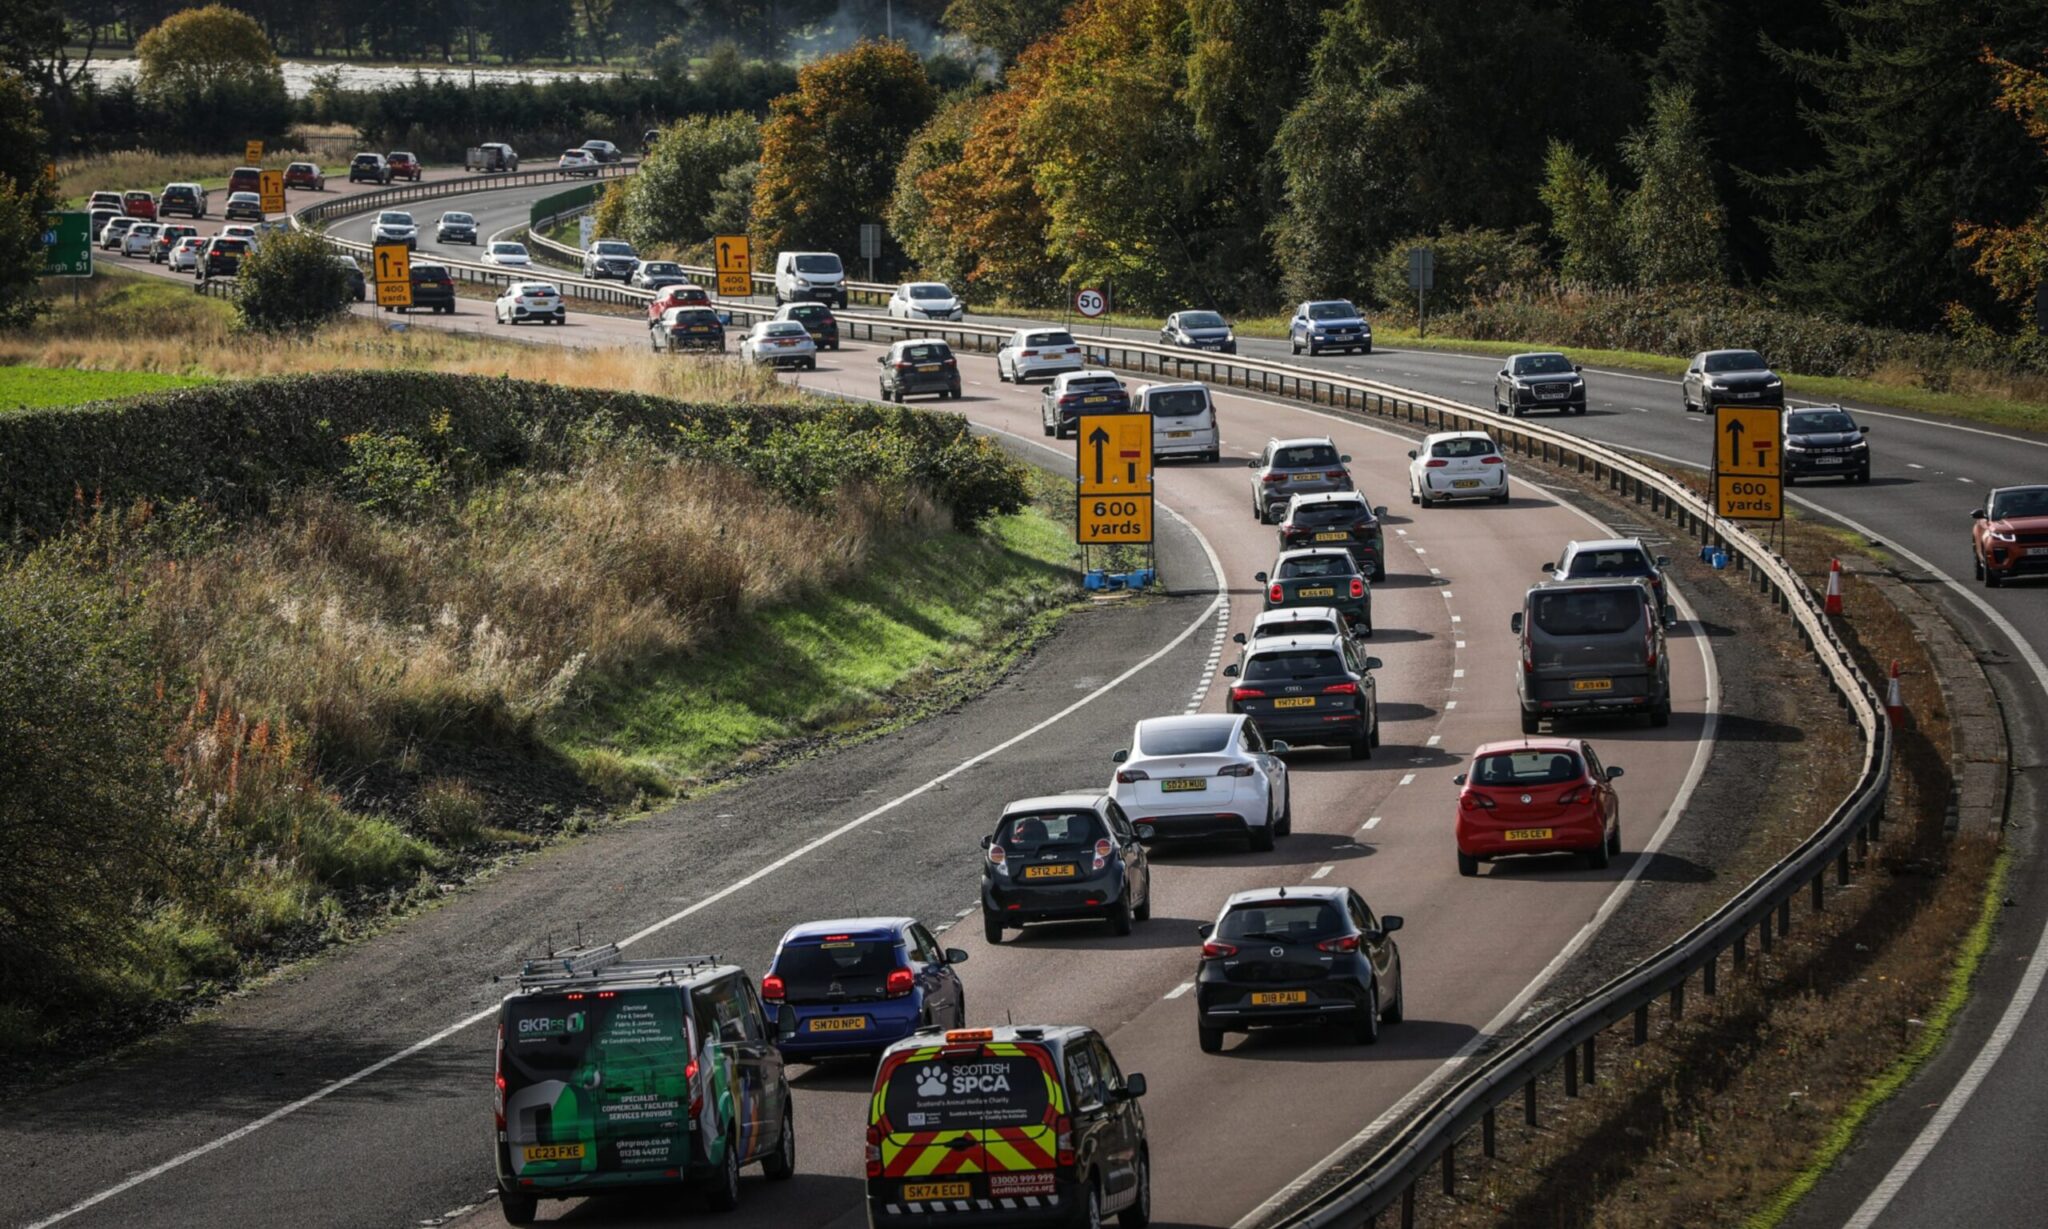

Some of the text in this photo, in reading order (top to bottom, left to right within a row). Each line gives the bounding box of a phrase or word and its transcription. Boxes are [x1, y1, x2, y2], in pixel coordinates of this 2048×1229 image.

[81, 232, 88, 242] 7
[81, 250, 89, 260] 9
[75, 261, 88, 271] 51
[384, 285, 404, 293] 400
[383, 294, 407, 302] yards
[1080, 295, 1102, 309] 50
[1732, 482, 1766, 496] 600
[1093, 502, 1137, 517] 600
[1727, 499, 1772, 512] yards
[1090, 521, 1141, 537] yards
[1510, 831, 1529, 840] ST15
[1031, 866, 1069, 876] ST12 JJE
[1279, 993, 1299, 1002] PAU
[841, 1018, 862, 1028] NPC
[952, 1063, 1010, 1076] SCOTTISH
[952, 1075, 1011, 1094] SPCA
[621, 1094, 658, 1103] SPECIALIST
[988, 1096, 1009, 1104] Charity
[602, 1101, 679, 1112] COMMERCIAL FACILITIES
[609, 1109, 673, 1120] SERVICES PROVIDER
[616, 1138, 672, 1149] gkrgroup.co.uk
[558, 1145, 580, 1158] FXE
[1020, 1175, 1037, 1183] 999
[1038, 1173, 1055, 1182] 999
[908, 1185, 938, 1198] SK74
[991, 1184, 1055, 1194] scottishspca.org
